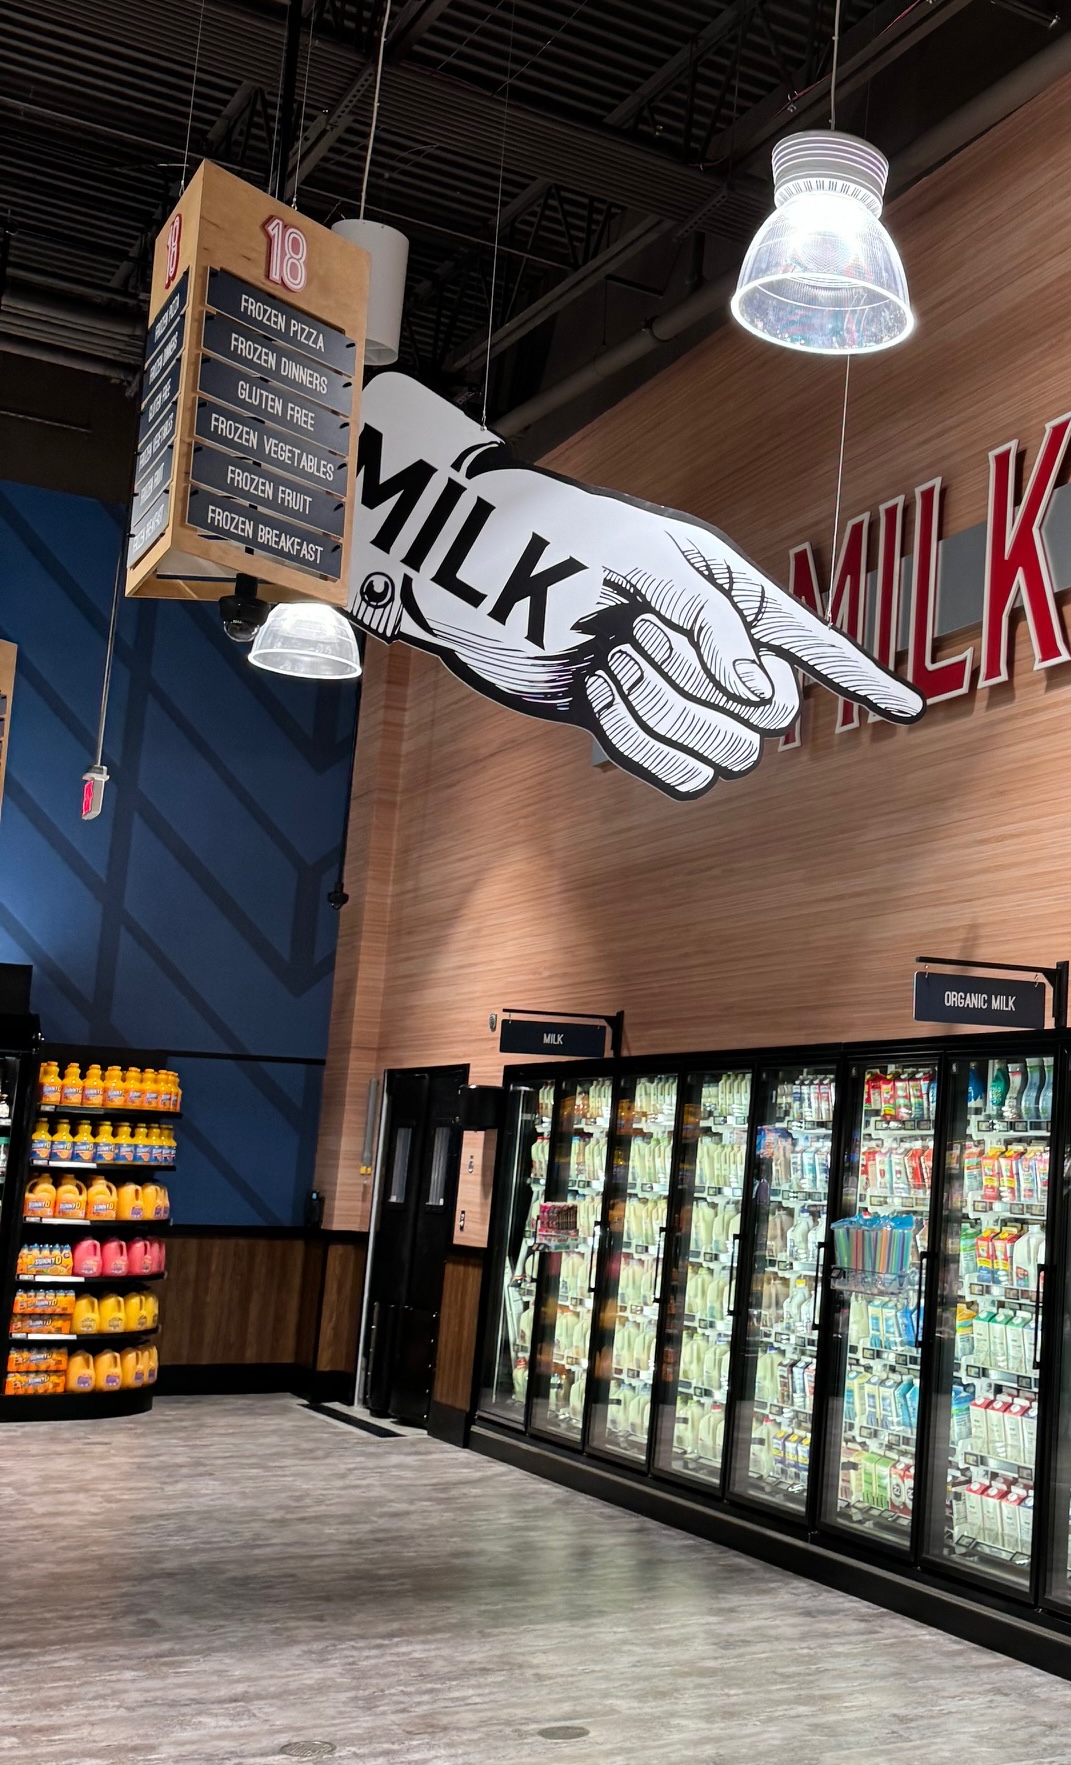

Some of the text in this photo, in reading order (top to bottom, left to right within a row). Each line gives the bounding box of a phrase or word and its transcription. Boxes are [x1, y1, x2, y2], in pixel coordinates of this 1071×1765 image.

[265, 215, 307, 292] 18
[240, 294, 325, 352] FROZEN PIZZA
[230, 333, 328, 394] FROZEN DINNERS
[238, 381, 315, 431] GLUTEN FREE
[210, 413, 334, 481] FROZEN VEGETABLES
[227, 466, 312, 514] FROZEN FRUIT
[207, 505, 323, 564] FROZEN BREAKFAST
[355, 421, 588, 649] MILK
[944, 991, 1016, 1012] ORGANIC MILK
[543, 1033, 564, 1046] MILK
